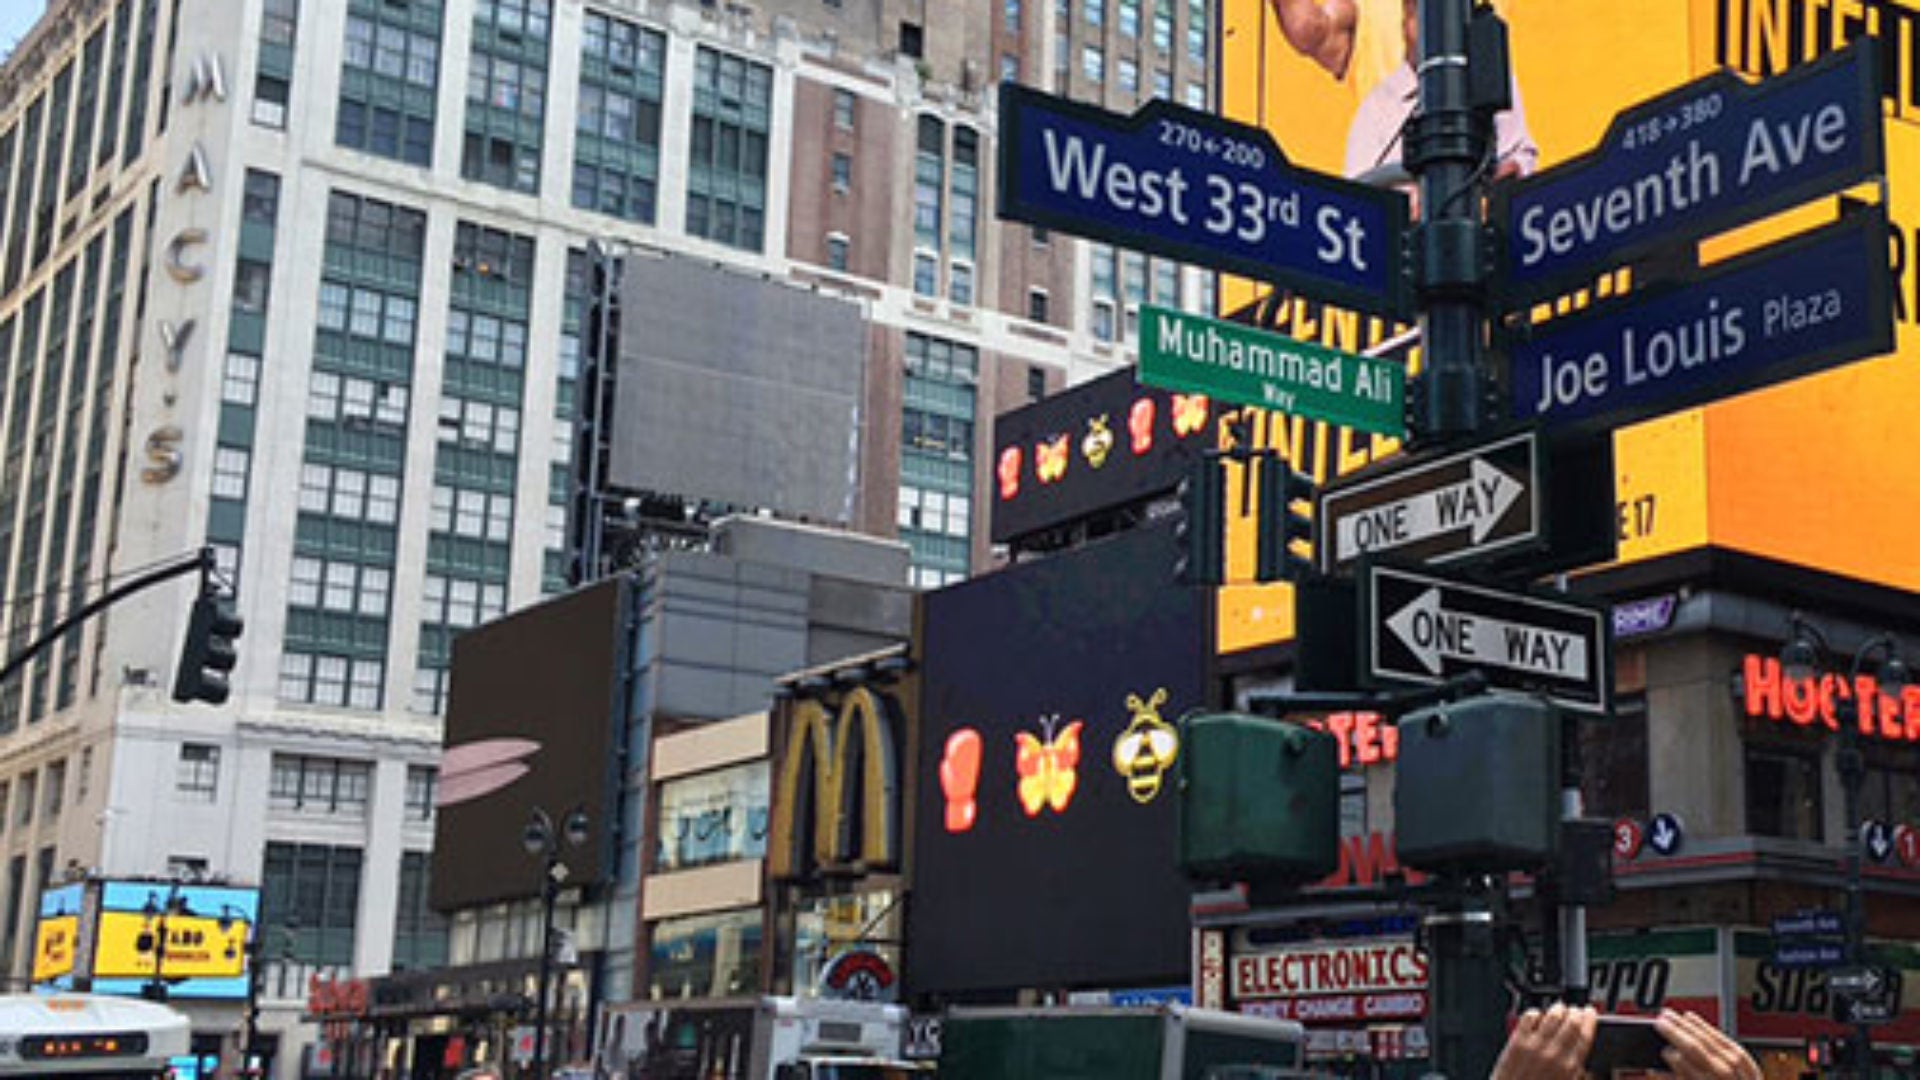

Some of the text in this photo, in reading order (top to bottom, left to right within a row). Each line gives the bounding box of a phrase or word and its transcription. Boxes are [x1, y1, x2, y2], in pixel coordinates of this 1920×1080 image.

[1042, 128, 1368, 270] West 33rd St
[1520, 103, 1847, 265] Seventh Ave
[1157, 314, 1343, 393] Muhammad
[1354, 357, 1393, 404] Ali
[1536, 288, 1842, 412] Joe Louis Plaza
[1263, 382, 1296, 411] Way
[1354, 474, 1501, 550] ONE WAY
[1633, 493, 1657, 537] 17
[1411, 608, 1571, 671] ONE WAY
[1616, 825, 1632, 852] 3
[1236, 945, 1429, 993] ELECTRONICS
